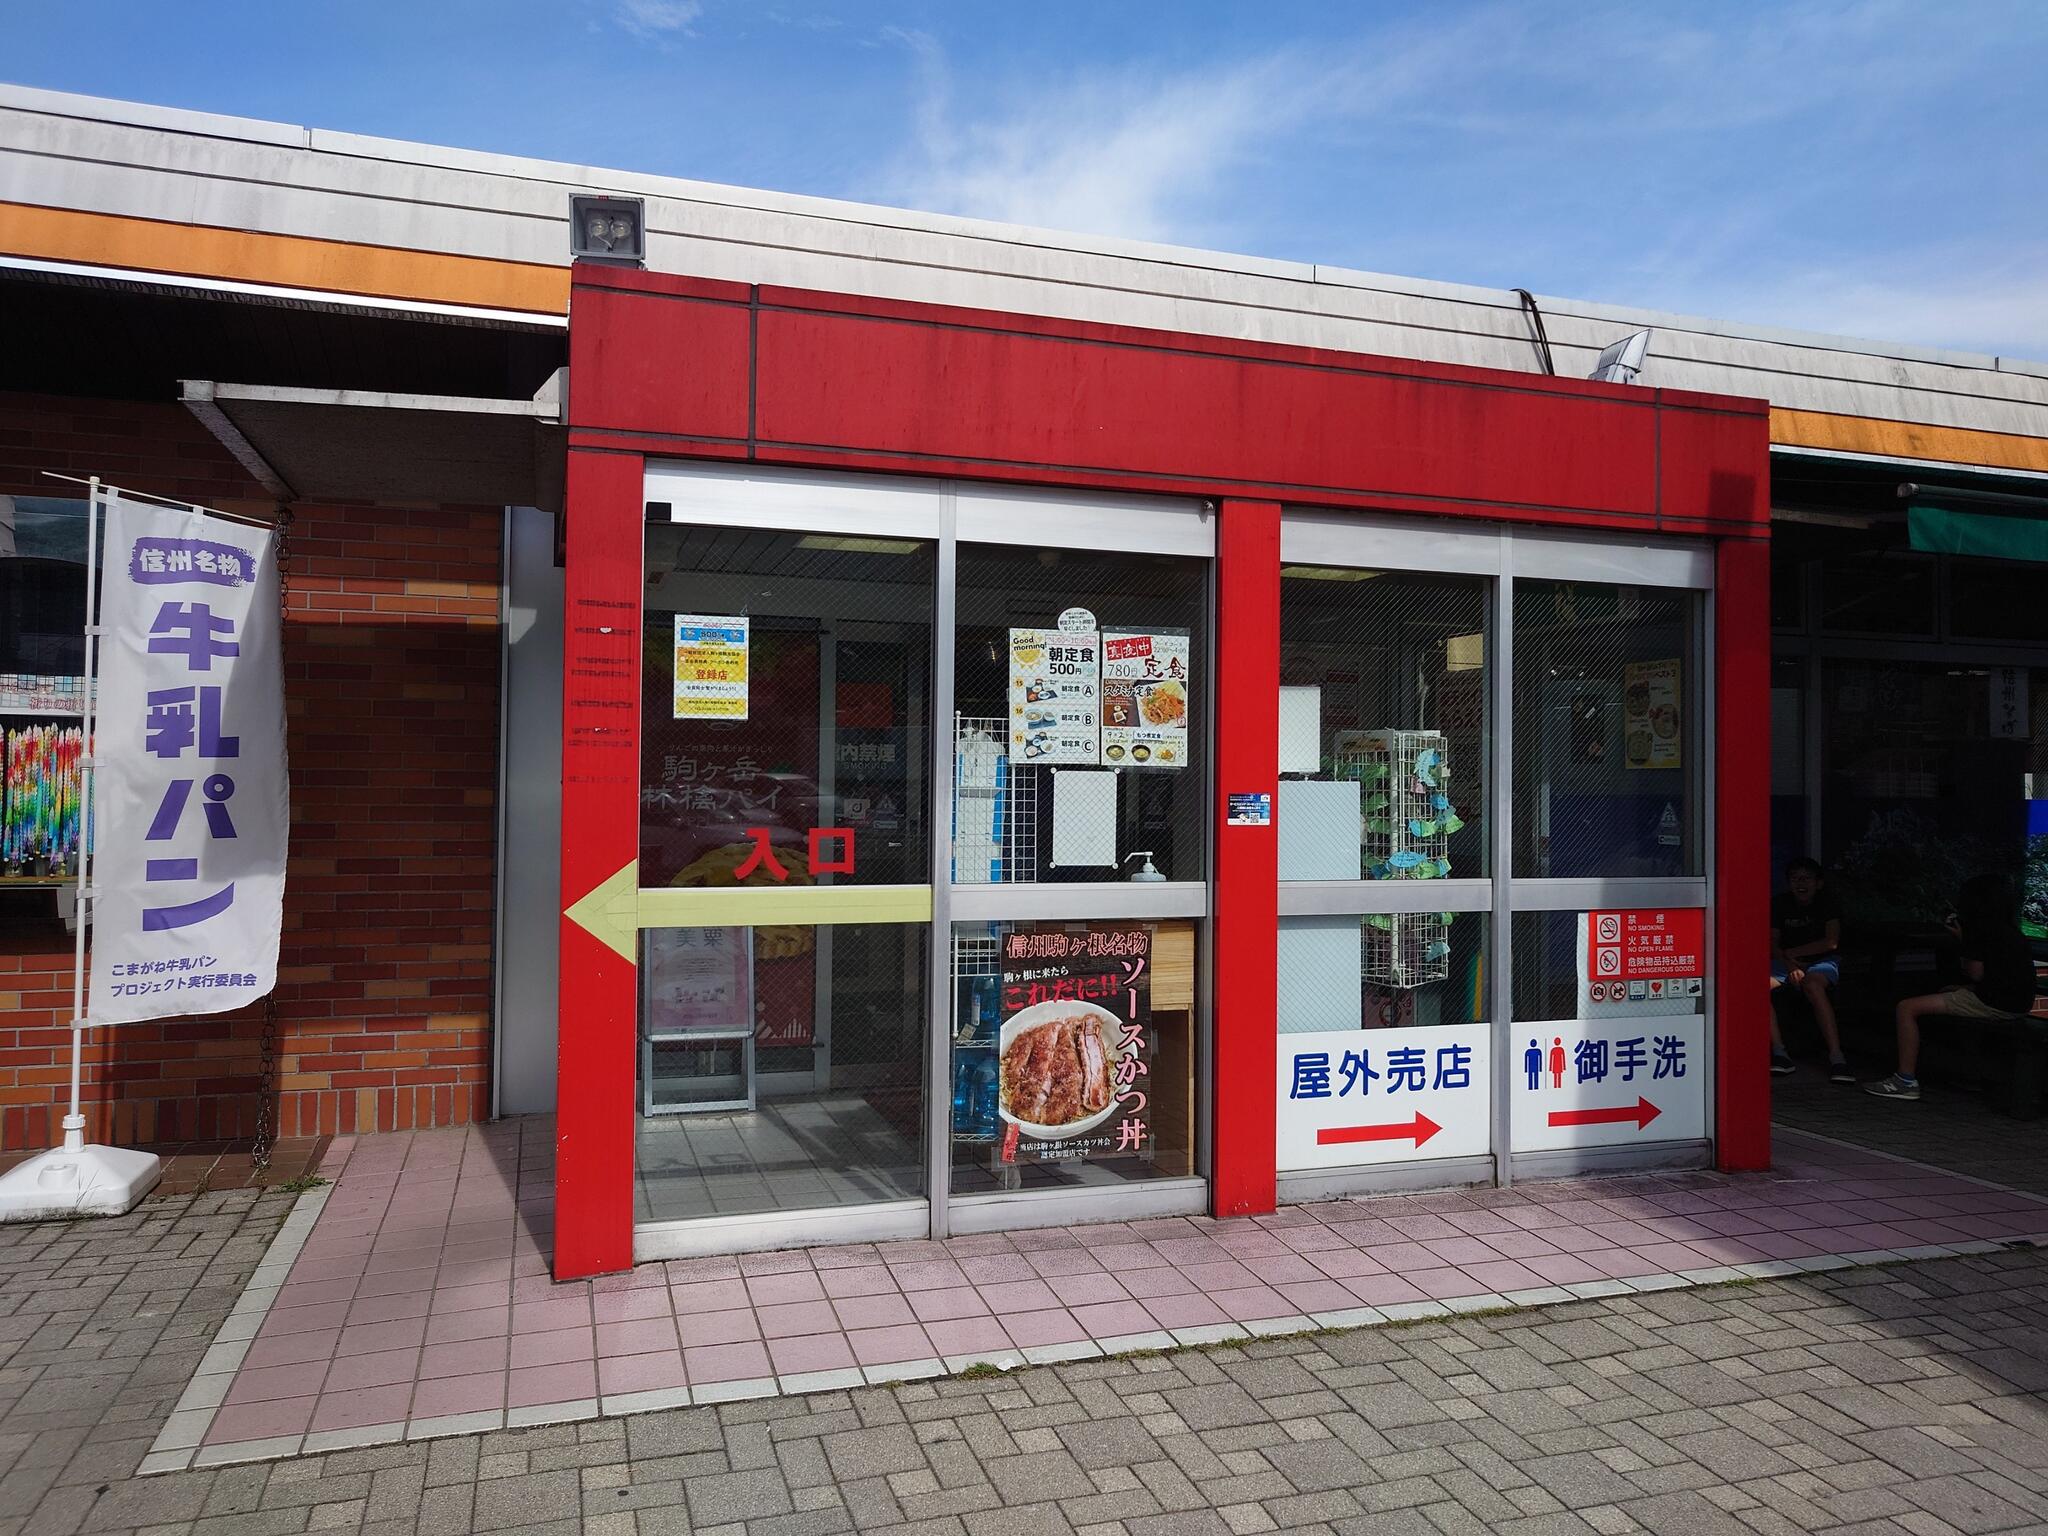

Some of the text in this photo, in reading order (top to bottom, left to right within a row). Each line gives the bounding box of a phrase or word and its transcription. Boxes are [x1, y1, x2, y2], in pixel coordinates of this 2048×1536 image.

[139, 546, 242, 578] 信州名物
[1013, 636, 1034, 645] Good
[1049, 647, 1094, 662] 朝定食
[695, 669, 728, 681] 登録店
[1049, 663, 1082, 675] 500円
[1143, 655, 1187, 680] 定食
[1104, 685, 1153, 697] スタミナ定食
[142, 601, 241, 932] 牛乳パン
[661, 755, 762, 782] 駒ヶ岳
[733, 827, 855, 880] 入口
[1627, 913, 1665, 924] 禁煙
[1006, 932, 1148, 958] 信州駒ヶ根名物
[1627, 935, 1674, 946] 火気厳禁
[111, 954, 218, 977] こまがね牛乳パン
[1003, 966, 1069, 983] 駒ヶ根に来たら
[110, 973, 257, 998] プロジェクト実行委員会
[1114, 957, 1148, 1153] ソースかつ丼
[1574, 1035, 1687, 1085] 御手洗
[1289, 1044, 1473, 1100] 屋外売店
